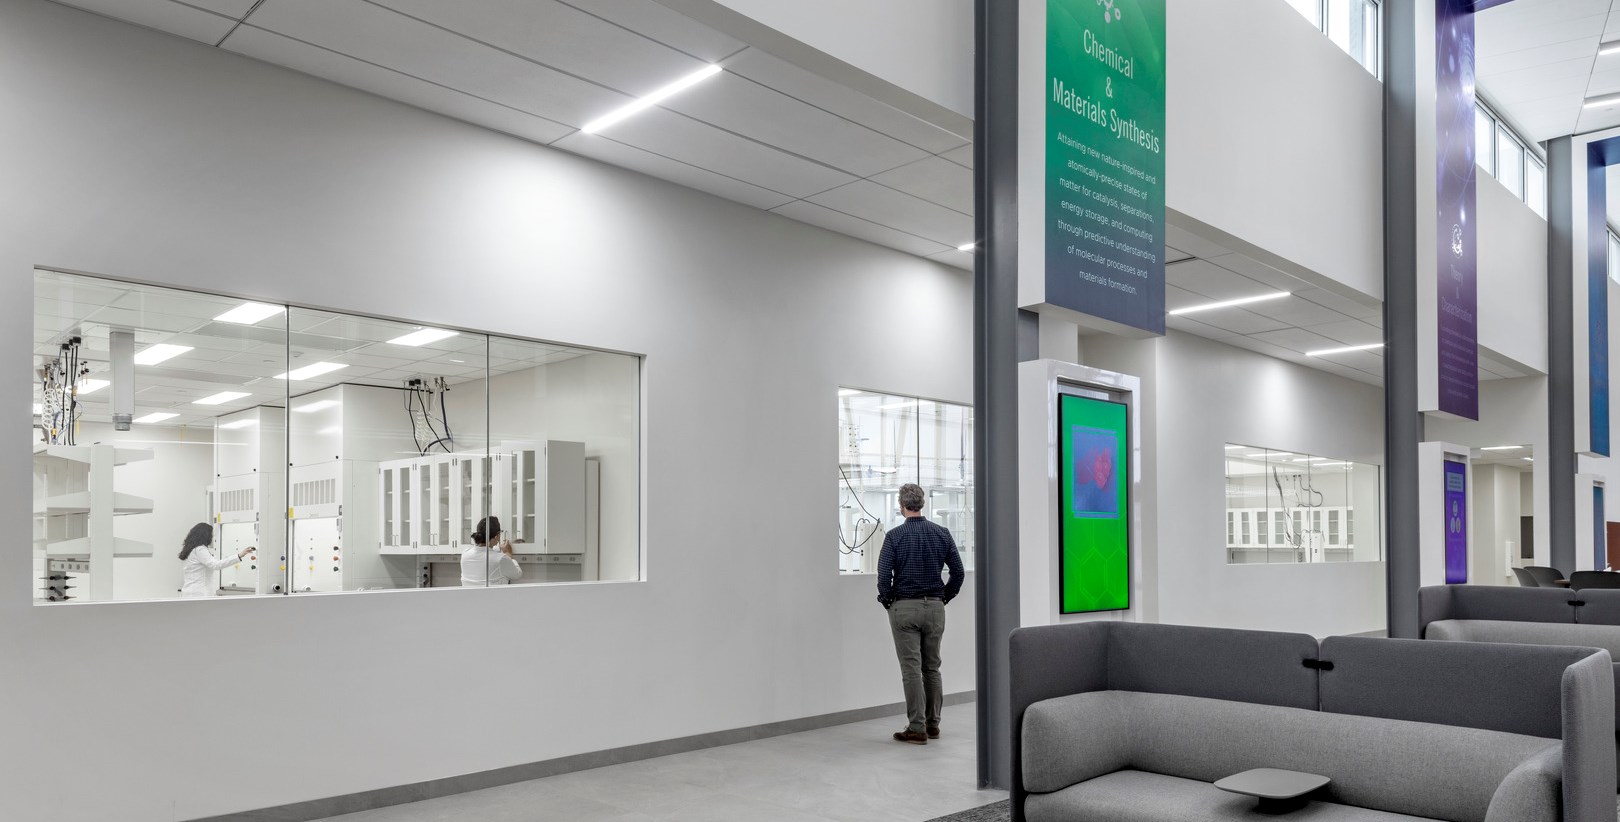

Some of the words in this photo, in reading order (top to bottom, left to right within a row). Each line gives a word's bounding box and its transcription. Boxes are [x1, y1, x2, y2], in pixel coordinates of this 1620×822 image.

[1083, 29, 1134, 79] Chemical
[1105, 76, 1113, 98] &
[1053, 77, 1107, 127] Materials
[1110, 108, 1160, 154] Synthesis
[1057, 132, 1086, 154] Attaining
[1087, 146, 1101, 159] new
[1101, 153, 1145, 180] nature-inspired
[1145, 173, 1156, 185] and
[1067, 158, 1122, 190] atomically-precise
[1123, 181, 1140, 197] states
[1141, 191, 1148, 201] of
[1059, 177, 1081, 192] matter
[1082, 185, 1091, 196] for
[1093, 190, 1120, 210] catalysis,
[1120, 202, 1155, 224] separations,
[1061, 199, 1084, 217] energy
[1085, 207, 1110, 226] storage,
[1111, 218, 1123, 231] and
[1124, 224, 1153, 243] computing
[1057, 219, 1084, 237] through
[1084, 230, 1115, 248] predictive
[1115, 241, 1156, 264] understanding
[1067, 244, 1075, 254] of
[1075, 247, 1106, 265] molecular
[1106, 258, 1136, 275] processes
[1137, 267, 1148, 279] and
[1079, 269, 1107, 287] materials
[1108, 278, 1138, 295] formation.
